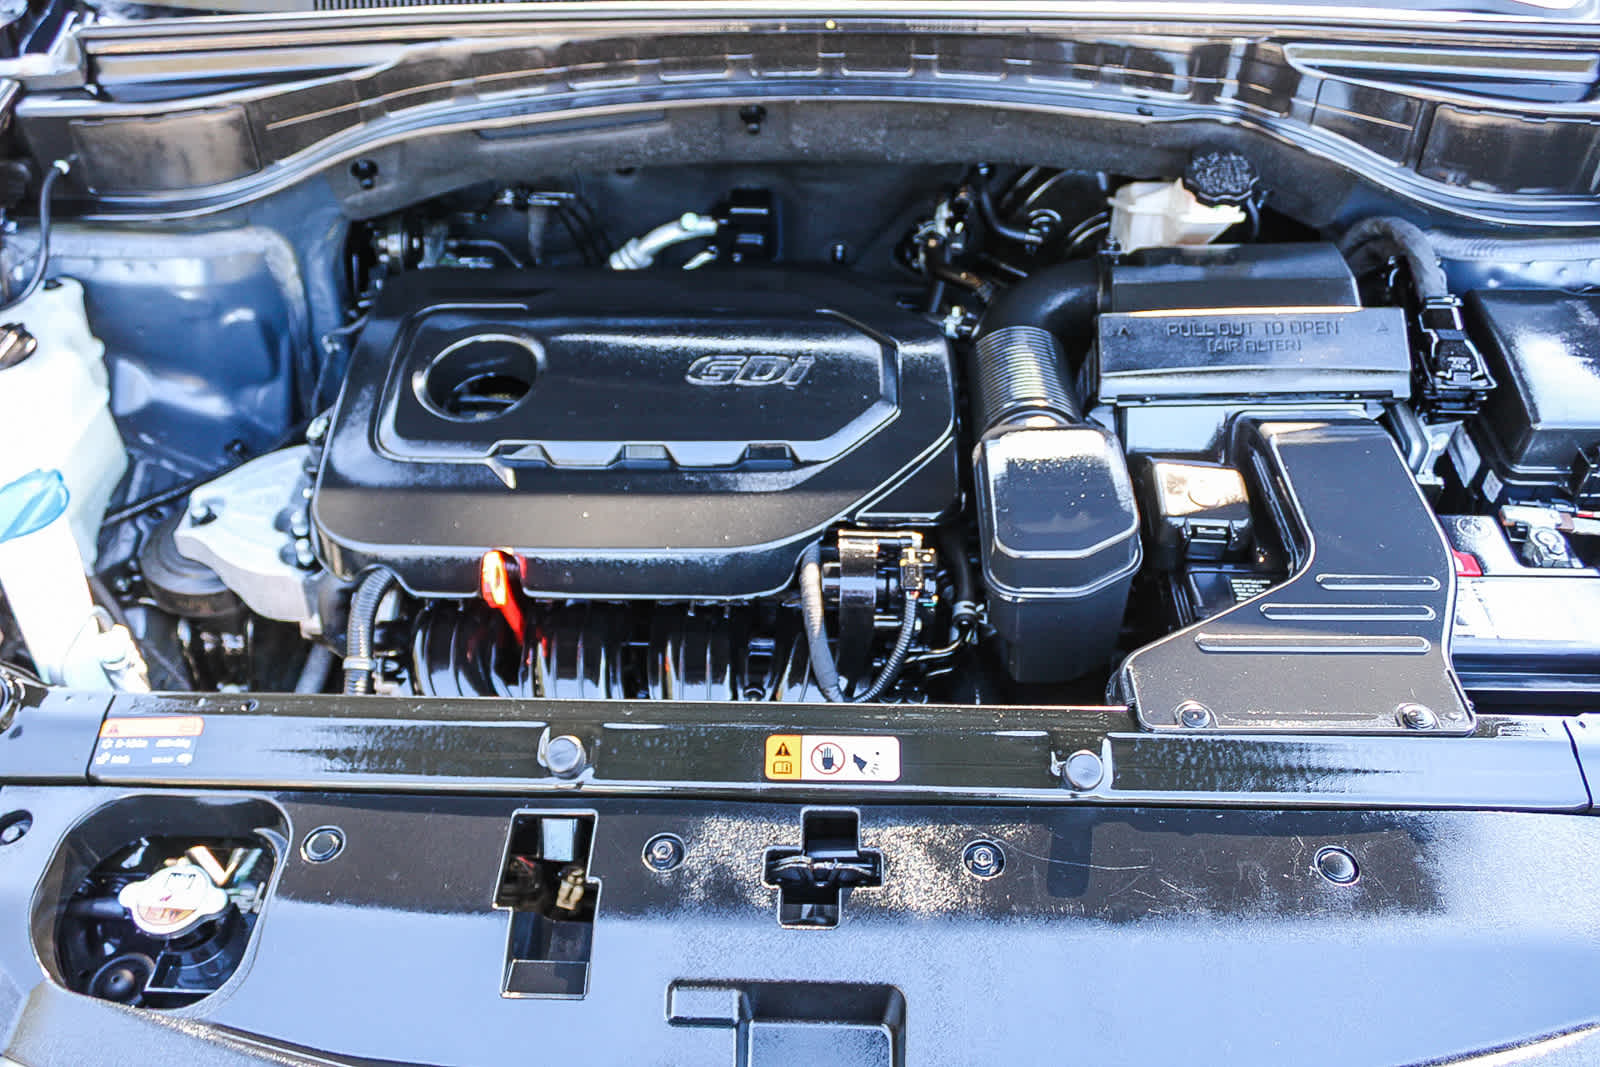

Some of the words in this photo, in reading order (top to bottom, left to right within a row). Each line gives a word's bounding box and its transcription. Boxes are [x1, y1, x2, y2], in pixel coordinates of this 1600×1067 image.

[1167, 321, 1214, 338] PULL
[1219, 320, 1254, 337] OUT
[1264, 320, 1285, 336] TO
[1290, 319, 1341, 336] OPEN
[685, 354, 816, 386] GDi
